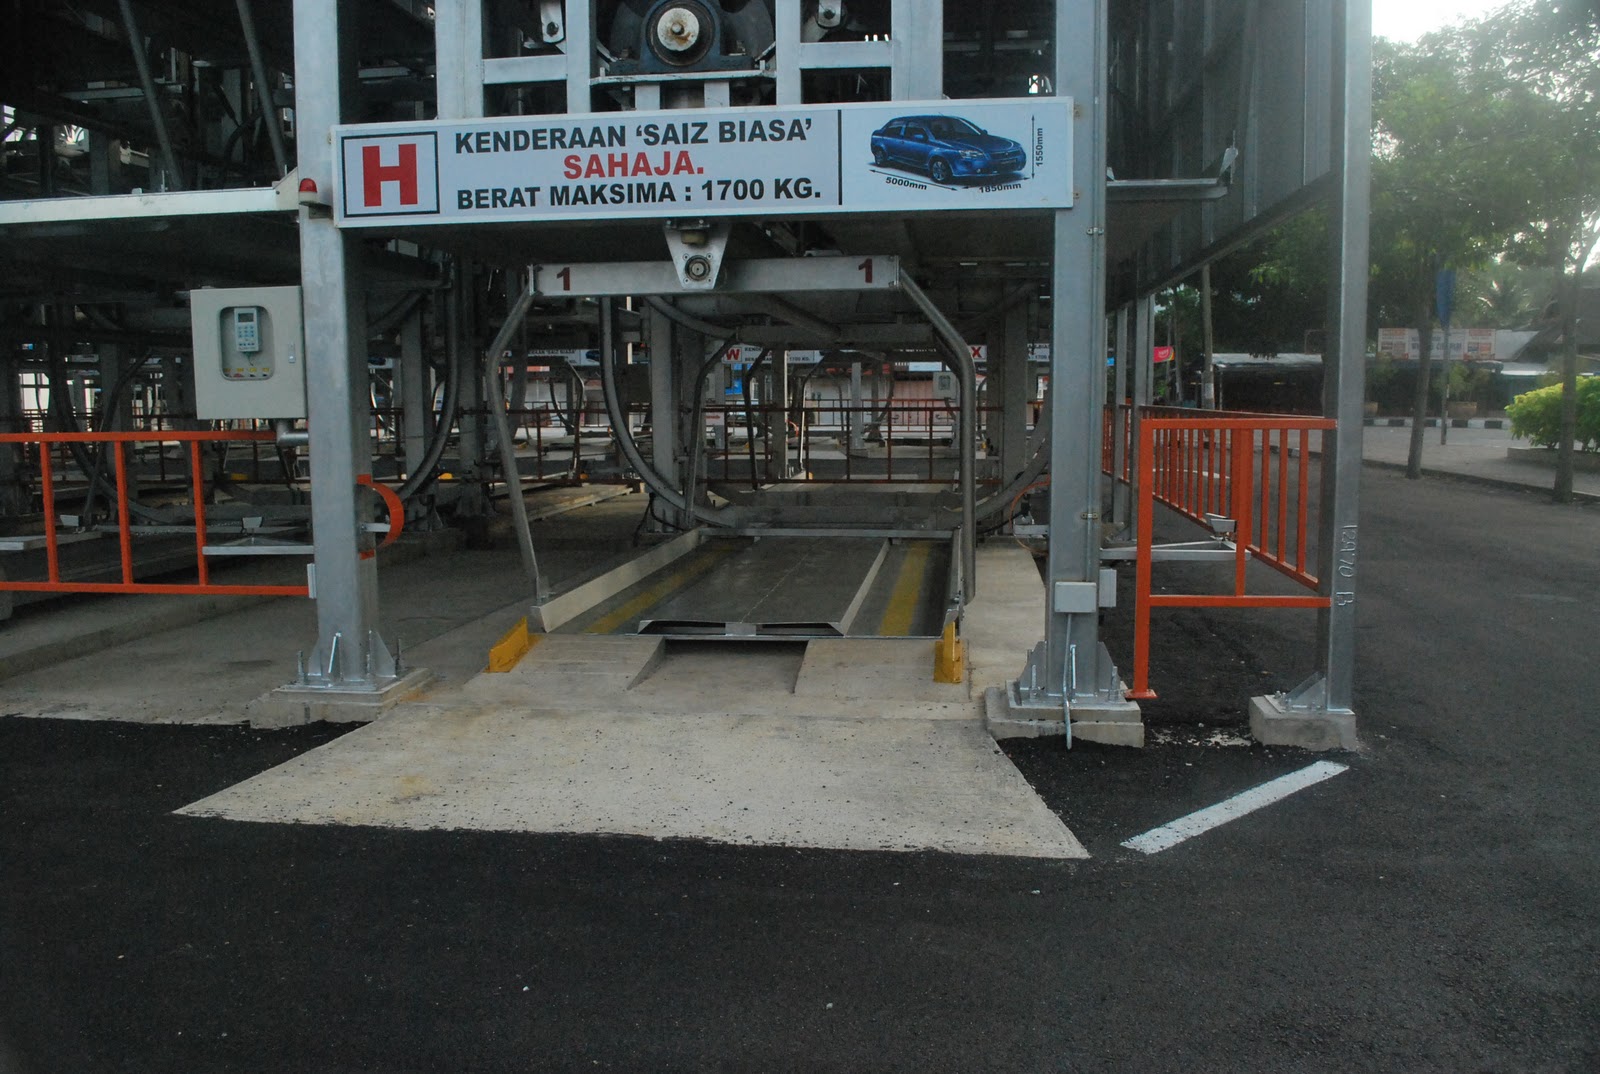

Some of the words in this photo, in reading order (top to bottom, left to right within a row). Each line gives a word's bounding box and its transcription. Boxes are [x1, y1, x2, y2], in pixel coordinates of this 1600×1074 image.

[456, 125, 626, 154] KENDERAAN
[362, 143, 418, 207] H
[563, 150, 704, 179] SAHAJA.
[458, 186, 540, 209] BERAT
[550, 182, 677, 207] MAKSIMA
[702, 179, 765, 201] 1700
[774, 178, 821, 199] KG.
[885, 176, 928, 191] 5000mm
[979, 182, 1022, 193] 1850mm
[556, 266, 570, 291] 1
[858, 258, 873, 283] 1
[726, 348, 740, 361] W
[971, 346, 982, 358] X
